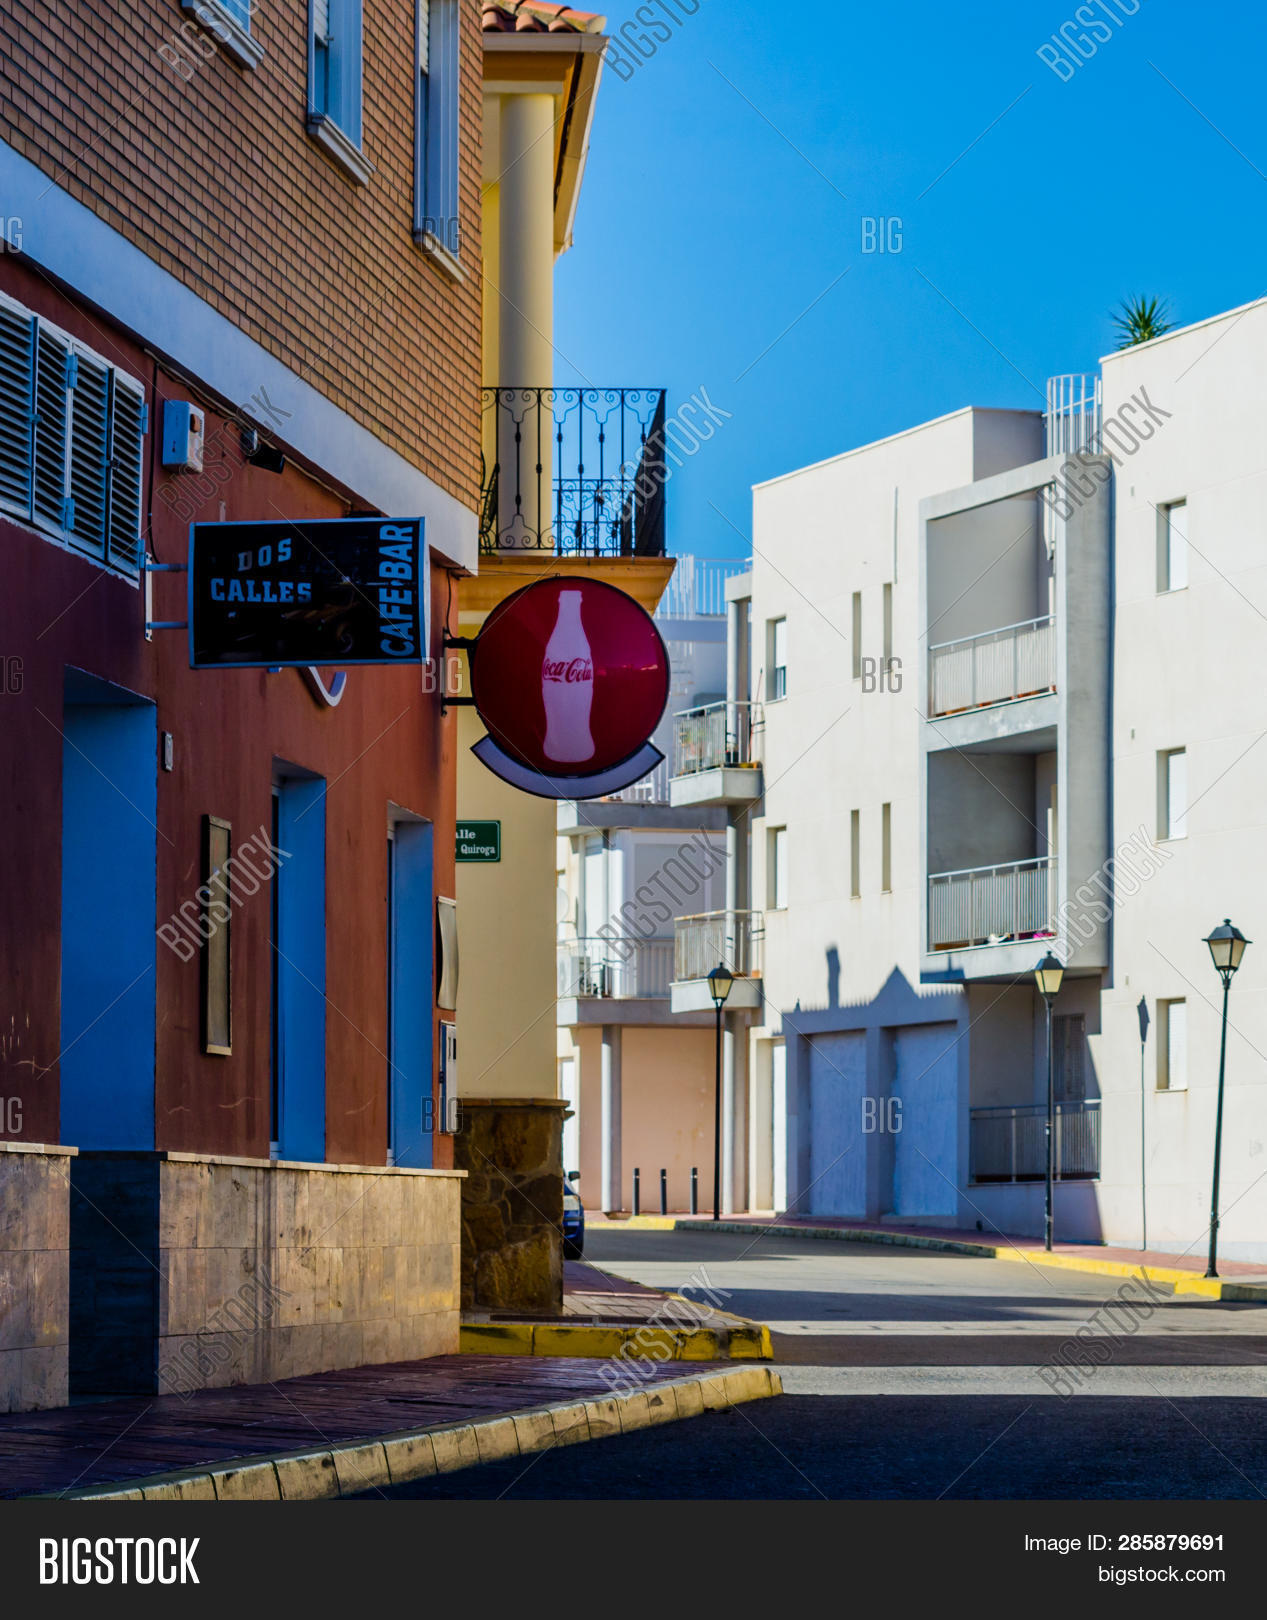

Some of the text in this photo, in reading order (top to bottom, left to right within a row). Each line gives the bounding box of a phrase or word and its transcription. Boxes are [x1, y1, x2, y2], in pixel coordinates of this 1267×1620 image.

[237, 537, 293, 572] DOS
[210, 577, 312, 603] CALLES
[460, 843, 496, 857] Quiroga
